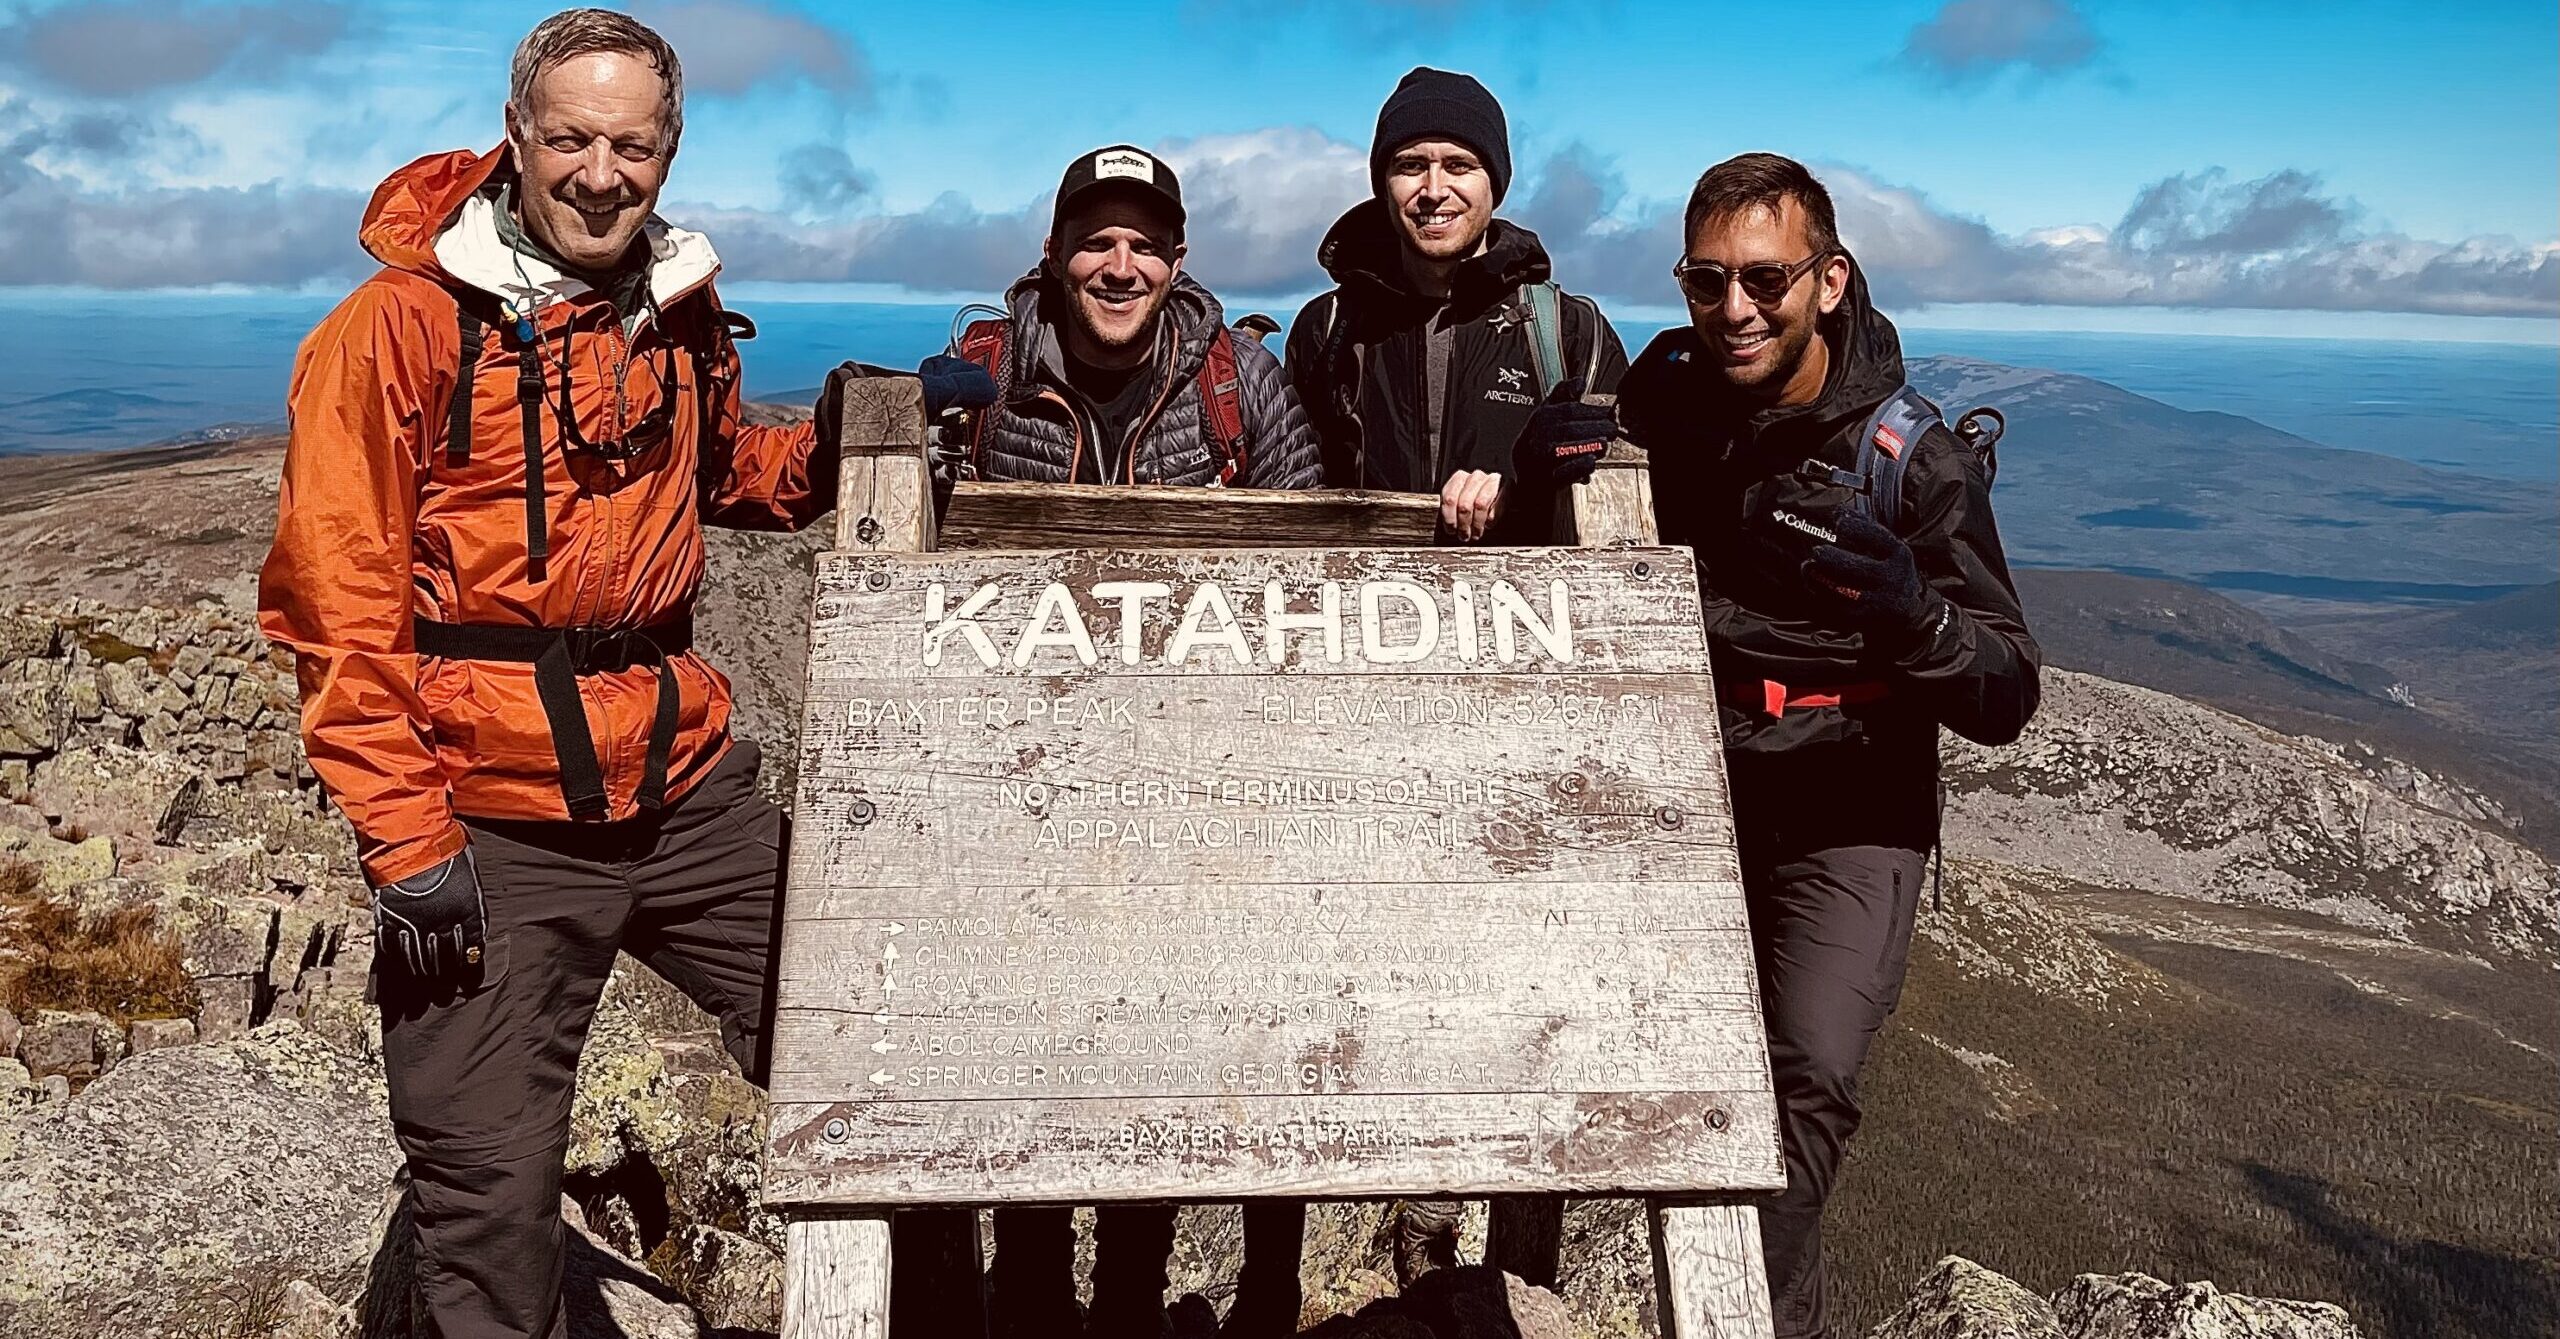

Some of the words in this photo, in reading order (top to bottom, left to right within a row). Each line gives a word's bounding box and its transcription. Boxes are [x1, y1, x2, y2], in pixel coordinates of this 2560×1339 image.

[1785, 513, 1837, 543] Columbia
[921, 579, 1575, 668] KATAHDIN
[847, 697, 1009, 728] BAXTER
[1025, 696, 1136, 727] PEAK
[1263, 694, 1489, 727] ELEVATION
[1512, 693, 1604, 726] 5267
[1199, 778, 1377, 807] TERMINUS
[1385, 778, 1430, 804] OF
[1438, 779, 1507, 805] THE
[1032, 816, 1338, 850] APPALACHIAN
[1350, 816, 1473, 849] TRAIL
[916, 917, 1027, 937] PAMOLA
[1035, 917, 1103, 936] PEAK
[1112, 916, 1148, 938] via
[1156, 915, 1233, 935] KNIFE
[914, 946, 1038, 966] CHIMNEY
[1046, 946, 1120, 965] POND
[1130, 943, 1323, 965] CAMPGROUND
[913, 975, 1036, 996] ROARING
[1047, 974, 1143, 995] BROOK
[1153, 973, 1347, 994] CAMPGROUND
[911, 1004, 1048, 1026] KATAHDIN
[1057, 1004, 1168, 1025] STREAM
[1177, 1002, 1374, 1024] CAMPGROUND
[908, 1035, 984, 1056] ABOL
[991, 1033, 1192, 1056] CAMPGROUND
[905, 1065, 1049, 1087] SPRINGER
[1221, 1063, 1347, 1085] GEORGIA
[1355, 1063, 1394, 1084] via
[1400, 1062, 1441, 1084] the
[1119, 1126, 1227, 1148] BAXTER
[1236, 1124, 1318, 1147] STATE
[1327, 1122, 1400, 1147] PARK
